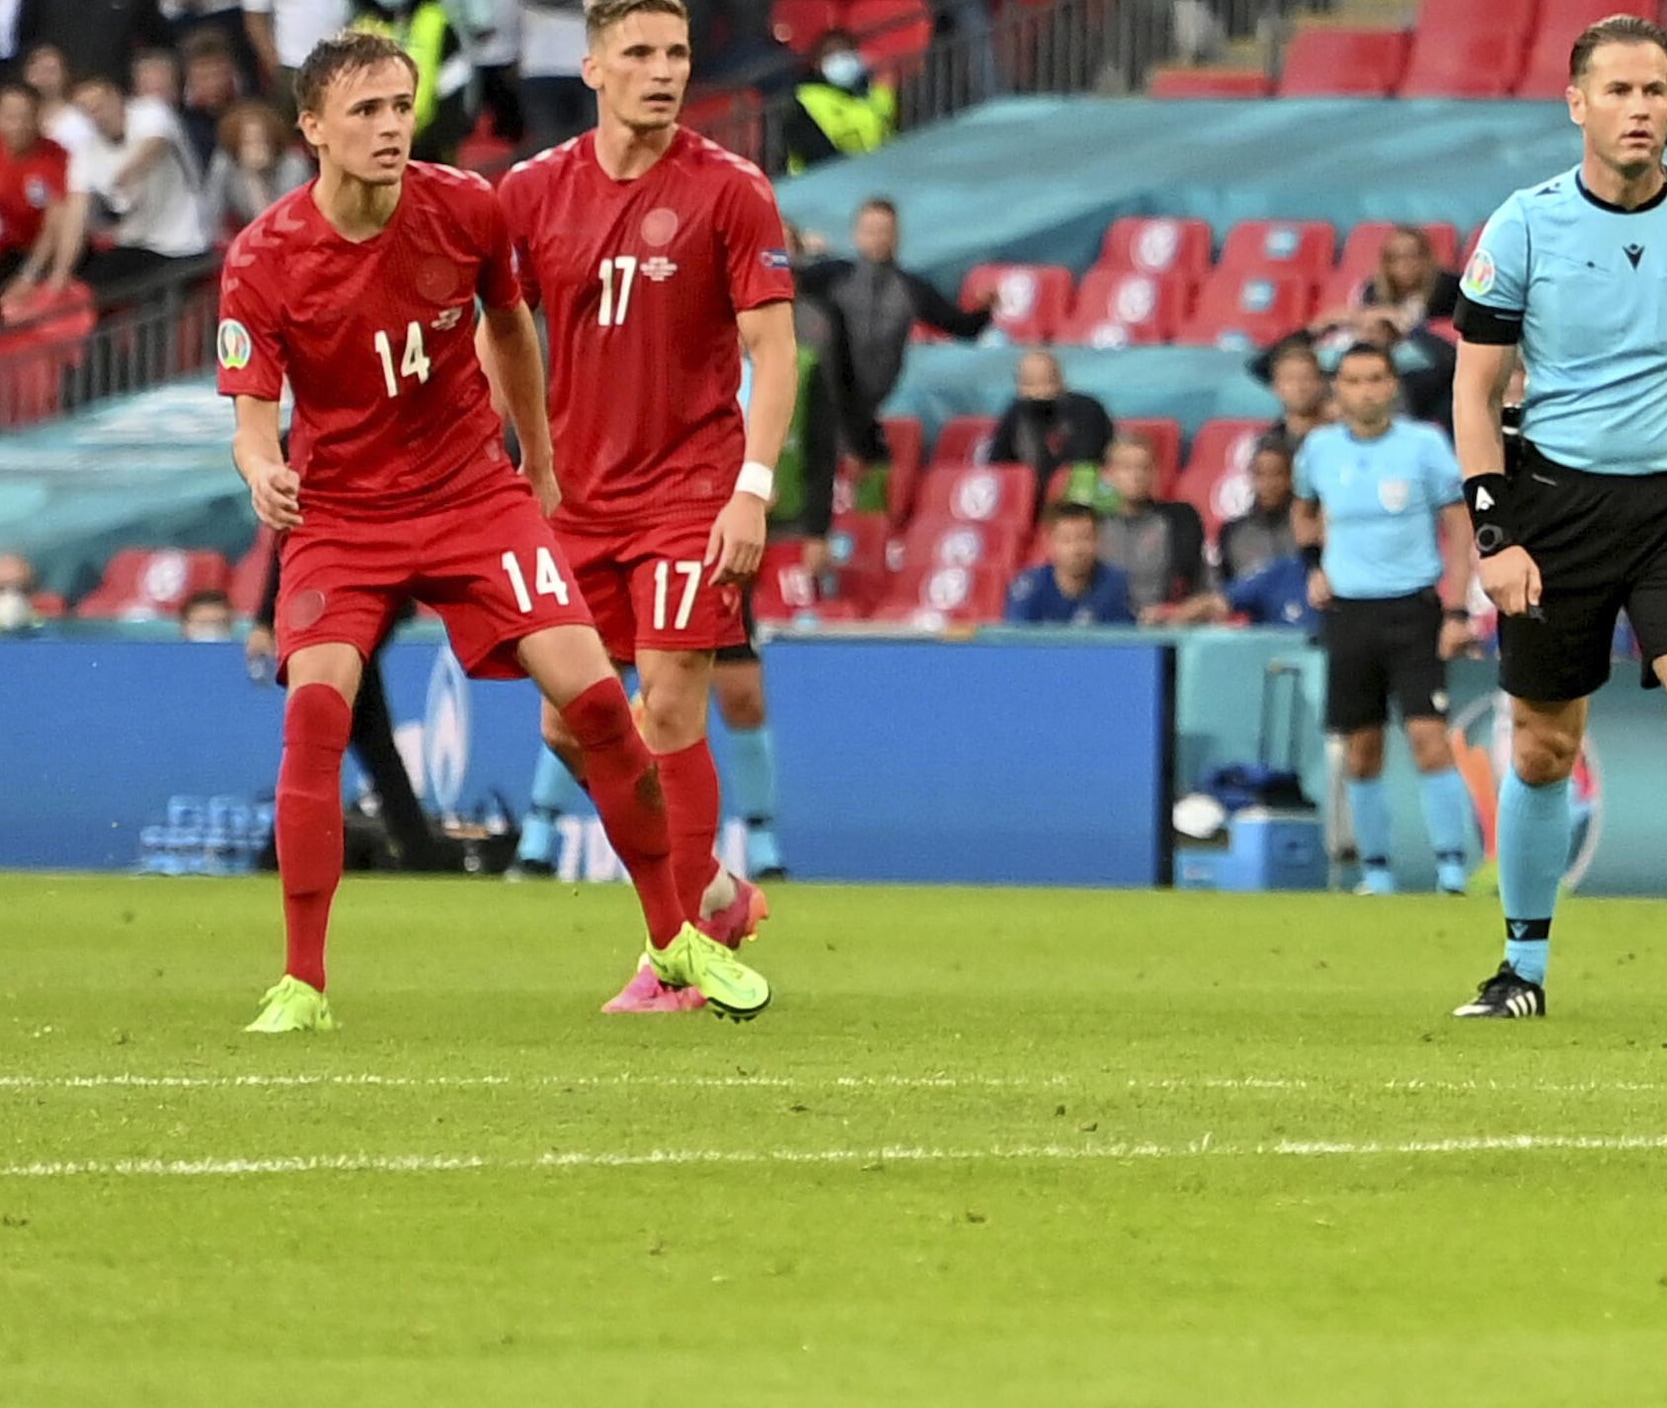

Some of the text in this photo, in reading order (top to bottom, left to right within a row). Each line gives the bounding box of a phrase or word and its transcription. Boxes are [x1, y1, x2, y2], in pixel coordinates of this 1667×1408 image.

[598, 256, 637, 326] 17
[375, 321, 431, 399] 14
[502, 546, 569, 614] 14
[654, 560, 702, 630] 17
